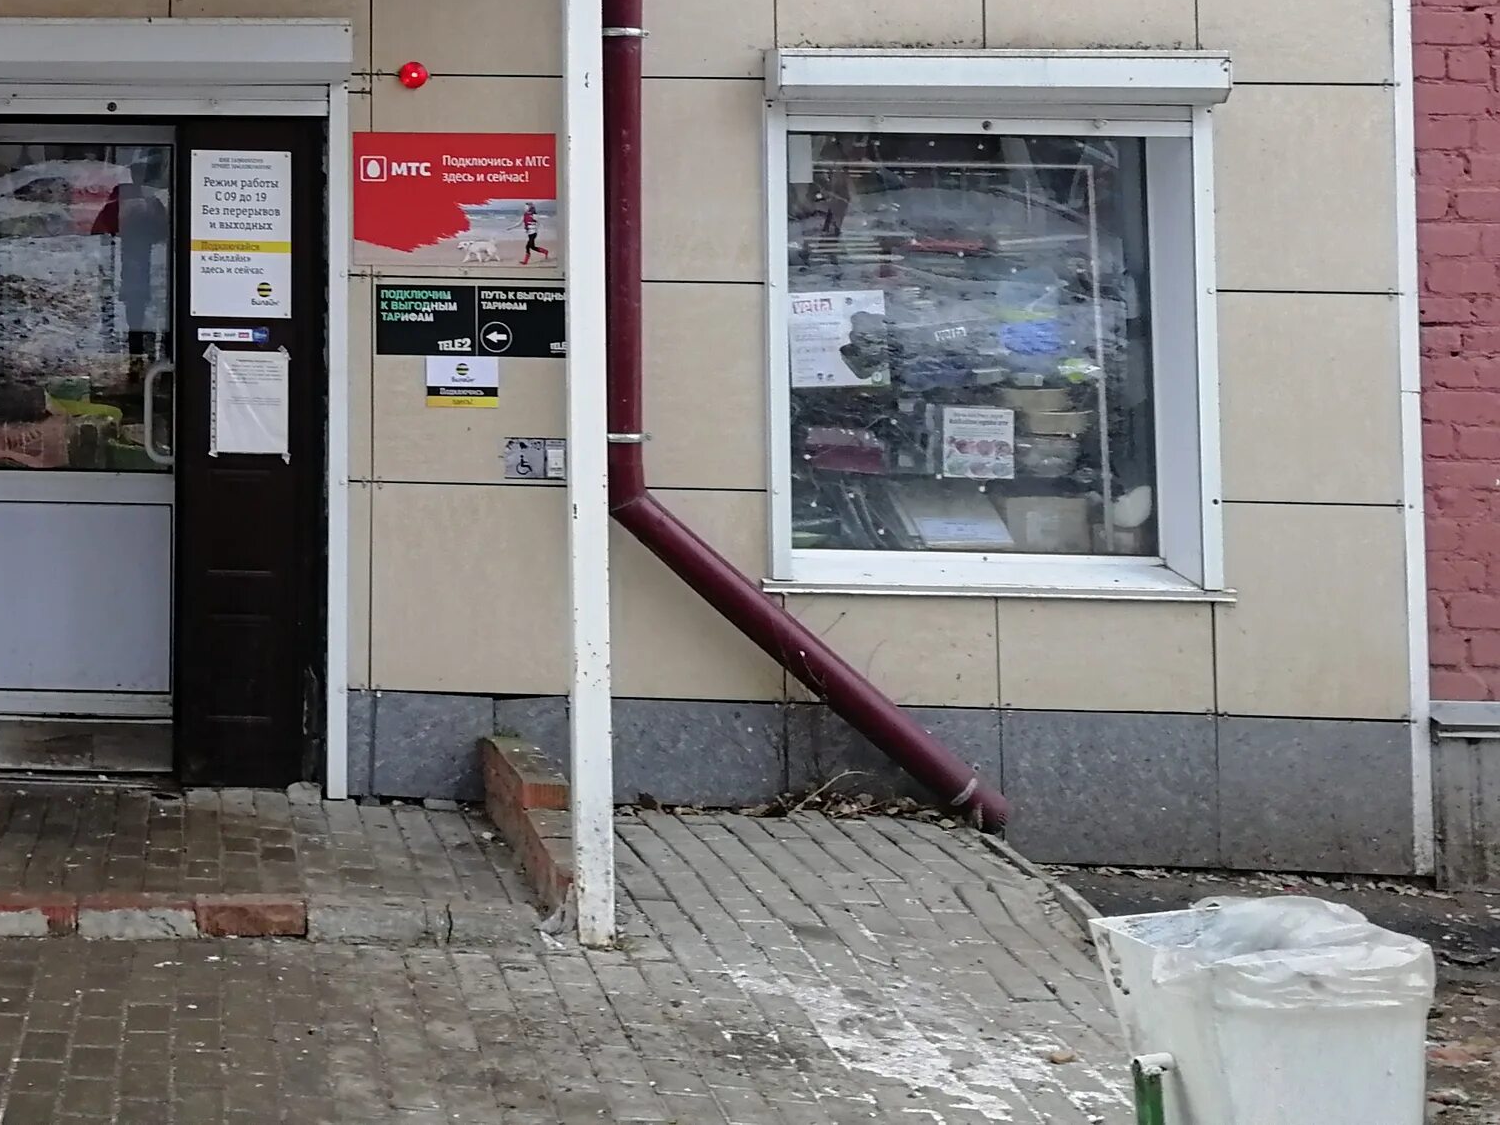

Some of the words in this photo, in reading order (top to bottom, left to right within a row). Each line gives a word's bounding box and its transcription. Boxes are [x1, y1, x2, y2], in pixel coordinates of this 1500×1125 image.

[442, 155, 513, 168] Подключись
[515, 158, 522, 167] к
[524, 155, 550, 167] МТС
[391, 161, 431, 177] МТС
[442, 172, 474, 184] здесь
[476, 172, 485, 182] и
[486, 170, 529, 183] сейчас!
[203, 177, 238, 188] Режим
[240, 178, 279, 190] работы
[215, 191, 222, 202] С
[224, 191, 237, 202] 09
[239, 194, 252, 203] до
[256, 192, 267, 202] 19
[202, 205, 220, 216] Без
[223, 207, 281, 218] перерывов
[219, 221, 273, 231] выходных
[481, 291, 506, 300] ПУТЬ
[509, 291, 515, 300] К
[517, 291, 566, 302] ВЫГОДНЫ
[381, 302, 388, 310] К
[391, 302, 457, 312] ВЫГОДНЫМ
[481, 301, 527, 311] ТАРИФАМ
[381, 312, 434, 322] ТАРИФАМ
[437, 337, 472, 352] TELE2
